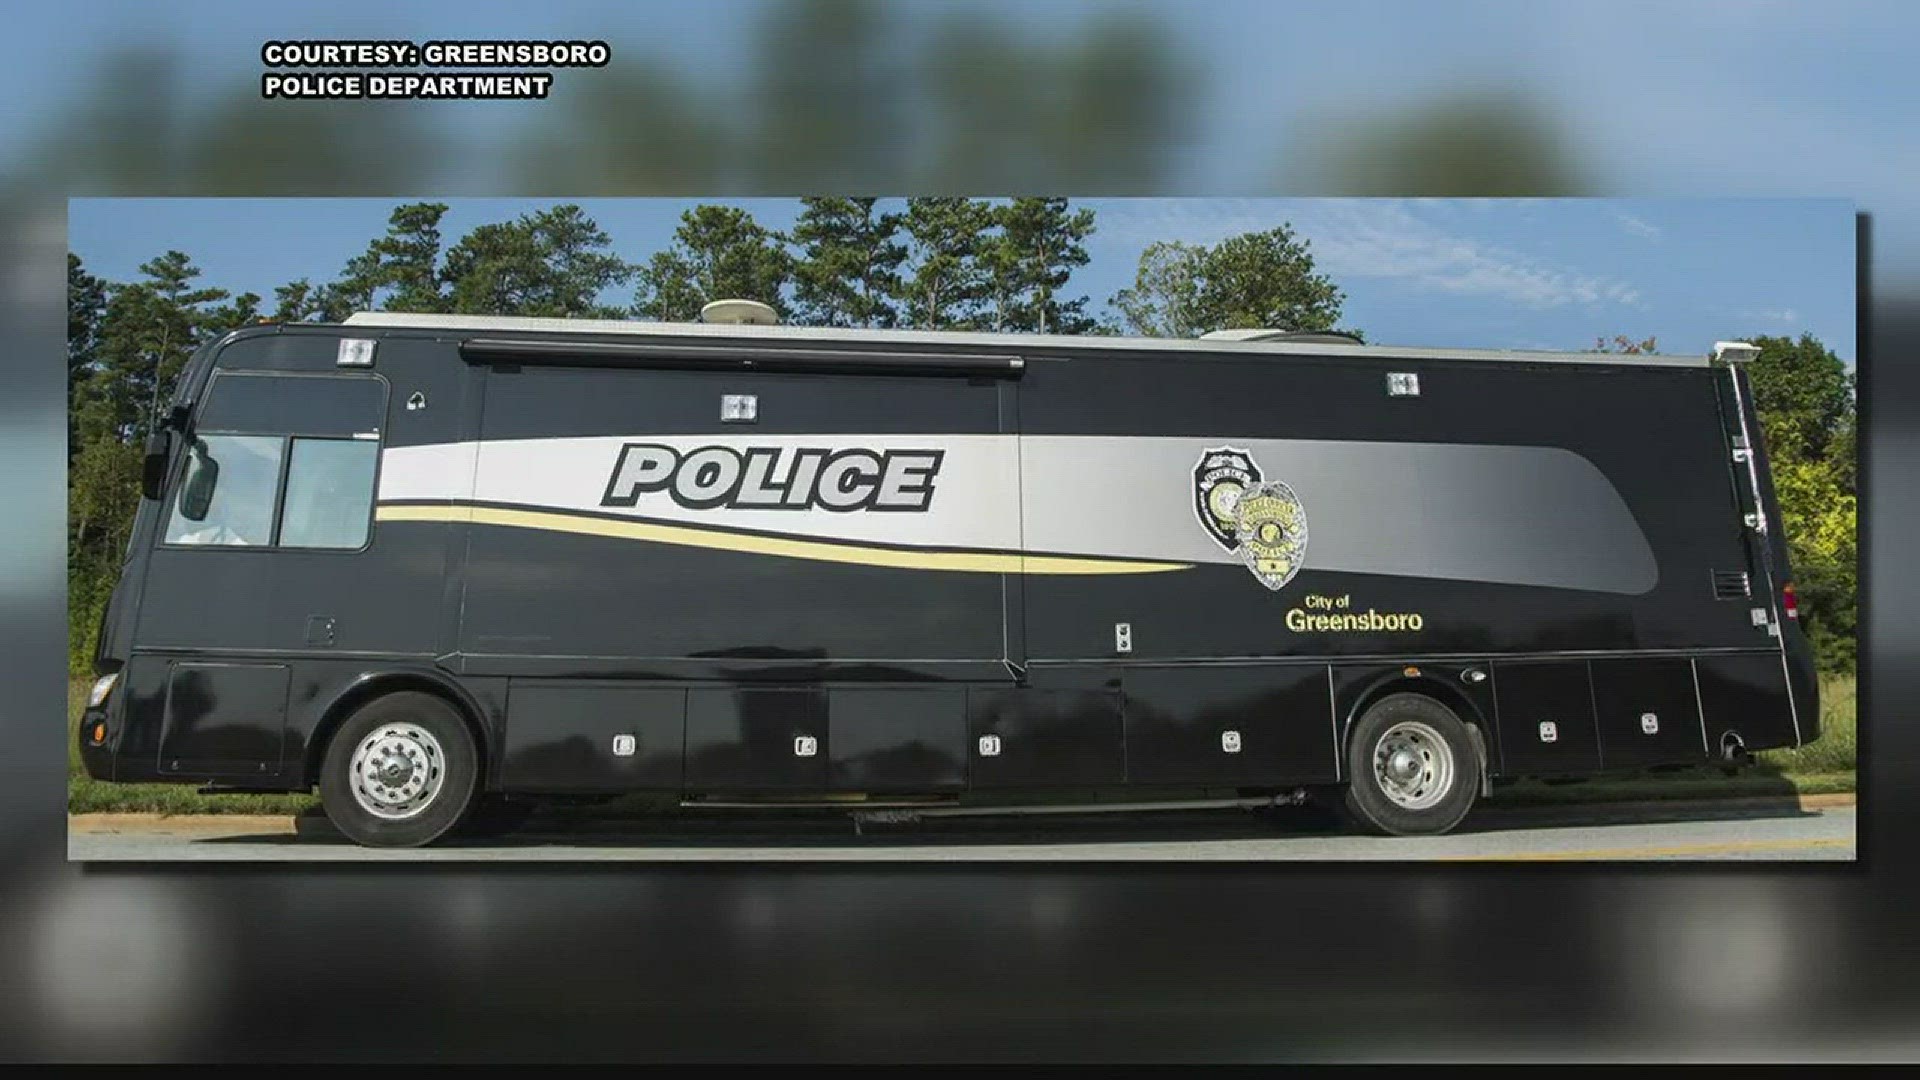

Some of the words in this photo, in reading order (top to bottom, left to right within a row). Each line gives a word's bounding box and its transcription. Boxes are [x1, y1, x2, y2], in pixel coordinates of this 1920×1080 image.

[601, 442, 944, 512] POLICE
[1305, 594, 1333, 611] City
[1335, 594, 1350, 609] of
[1285, 607, 1424, 632] Greensboro
